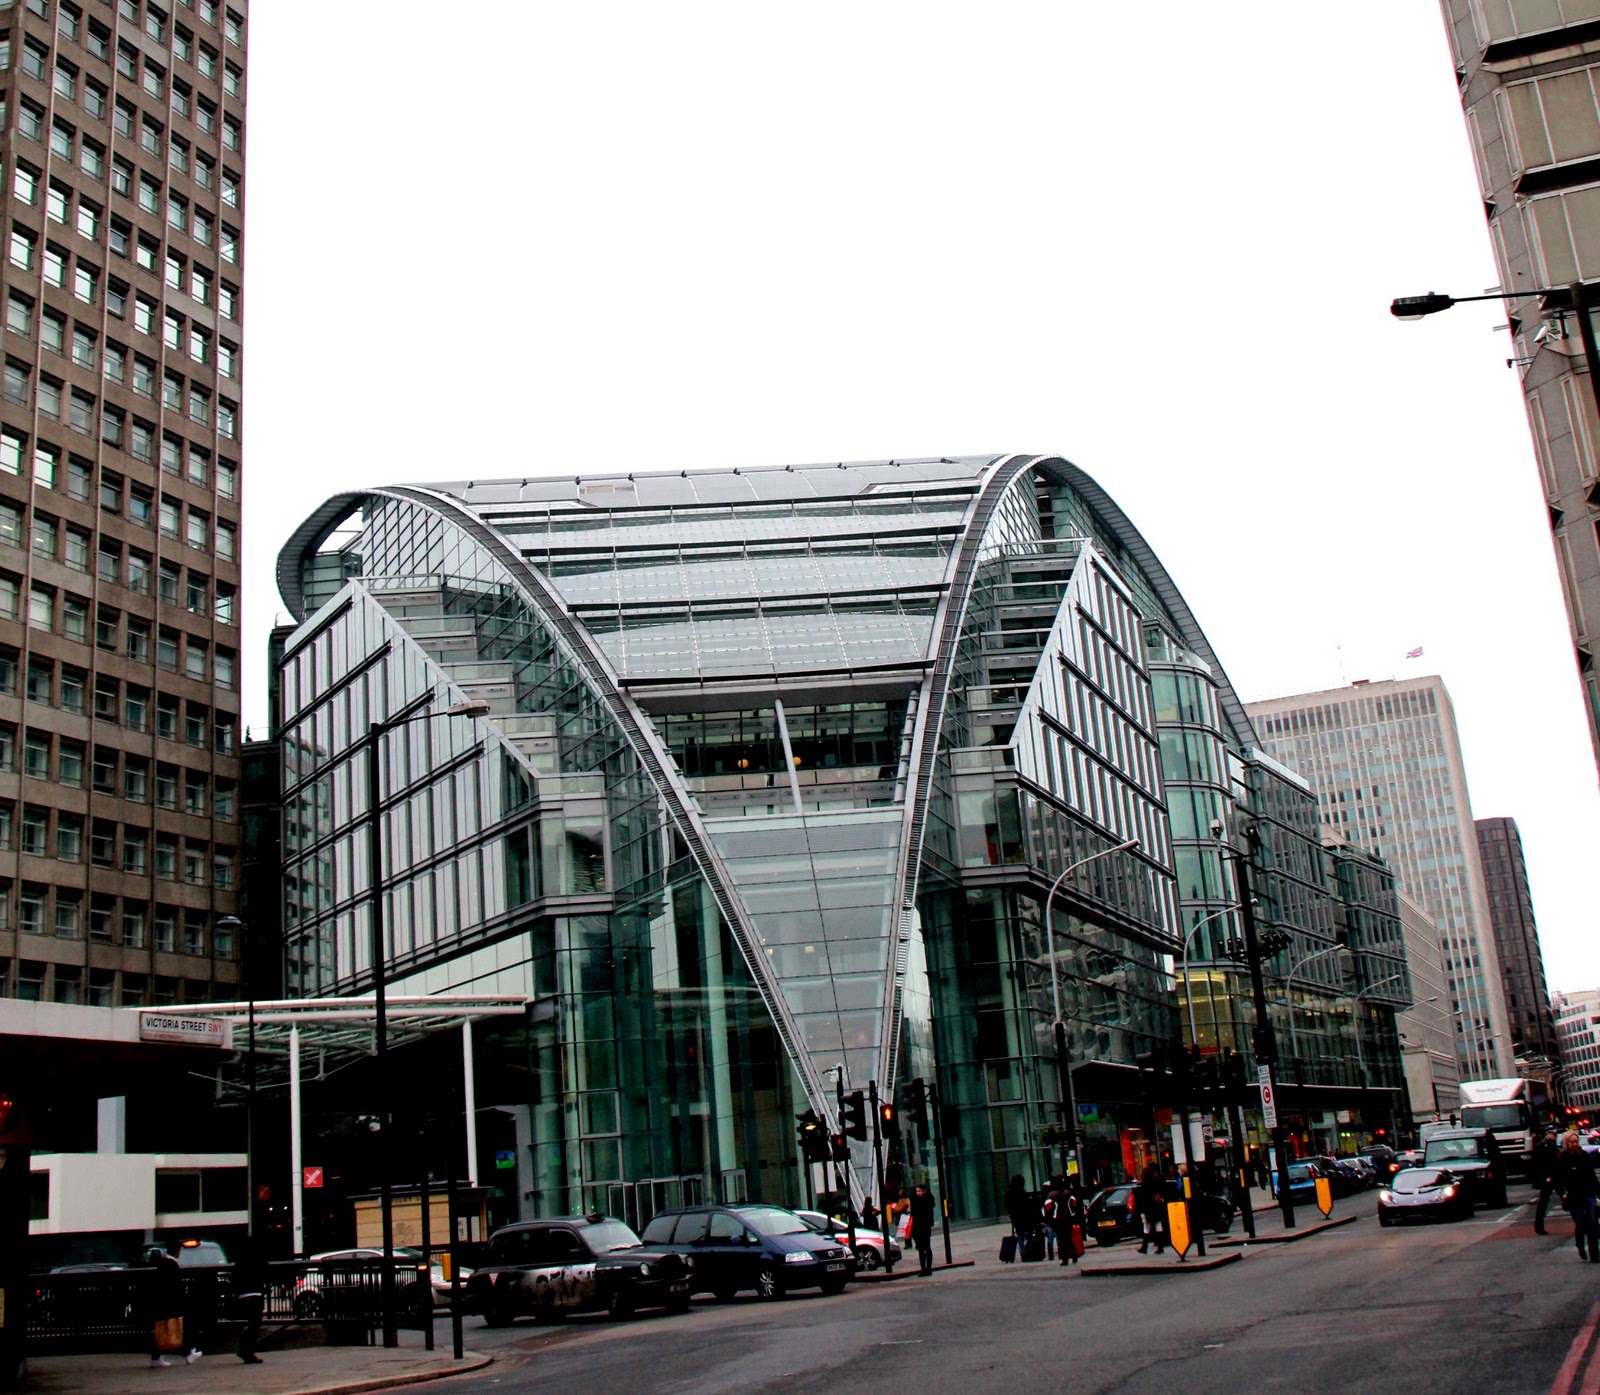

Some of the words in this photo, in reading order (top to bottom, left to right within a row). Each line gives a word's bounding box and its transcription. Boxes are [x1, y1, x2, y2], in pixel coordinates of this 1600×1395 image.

[146, 1018, 178, 1028] VICTORIA
[181, 1021, 206, 1031] STREET
[208, 1023, 222, 1032] SW1
